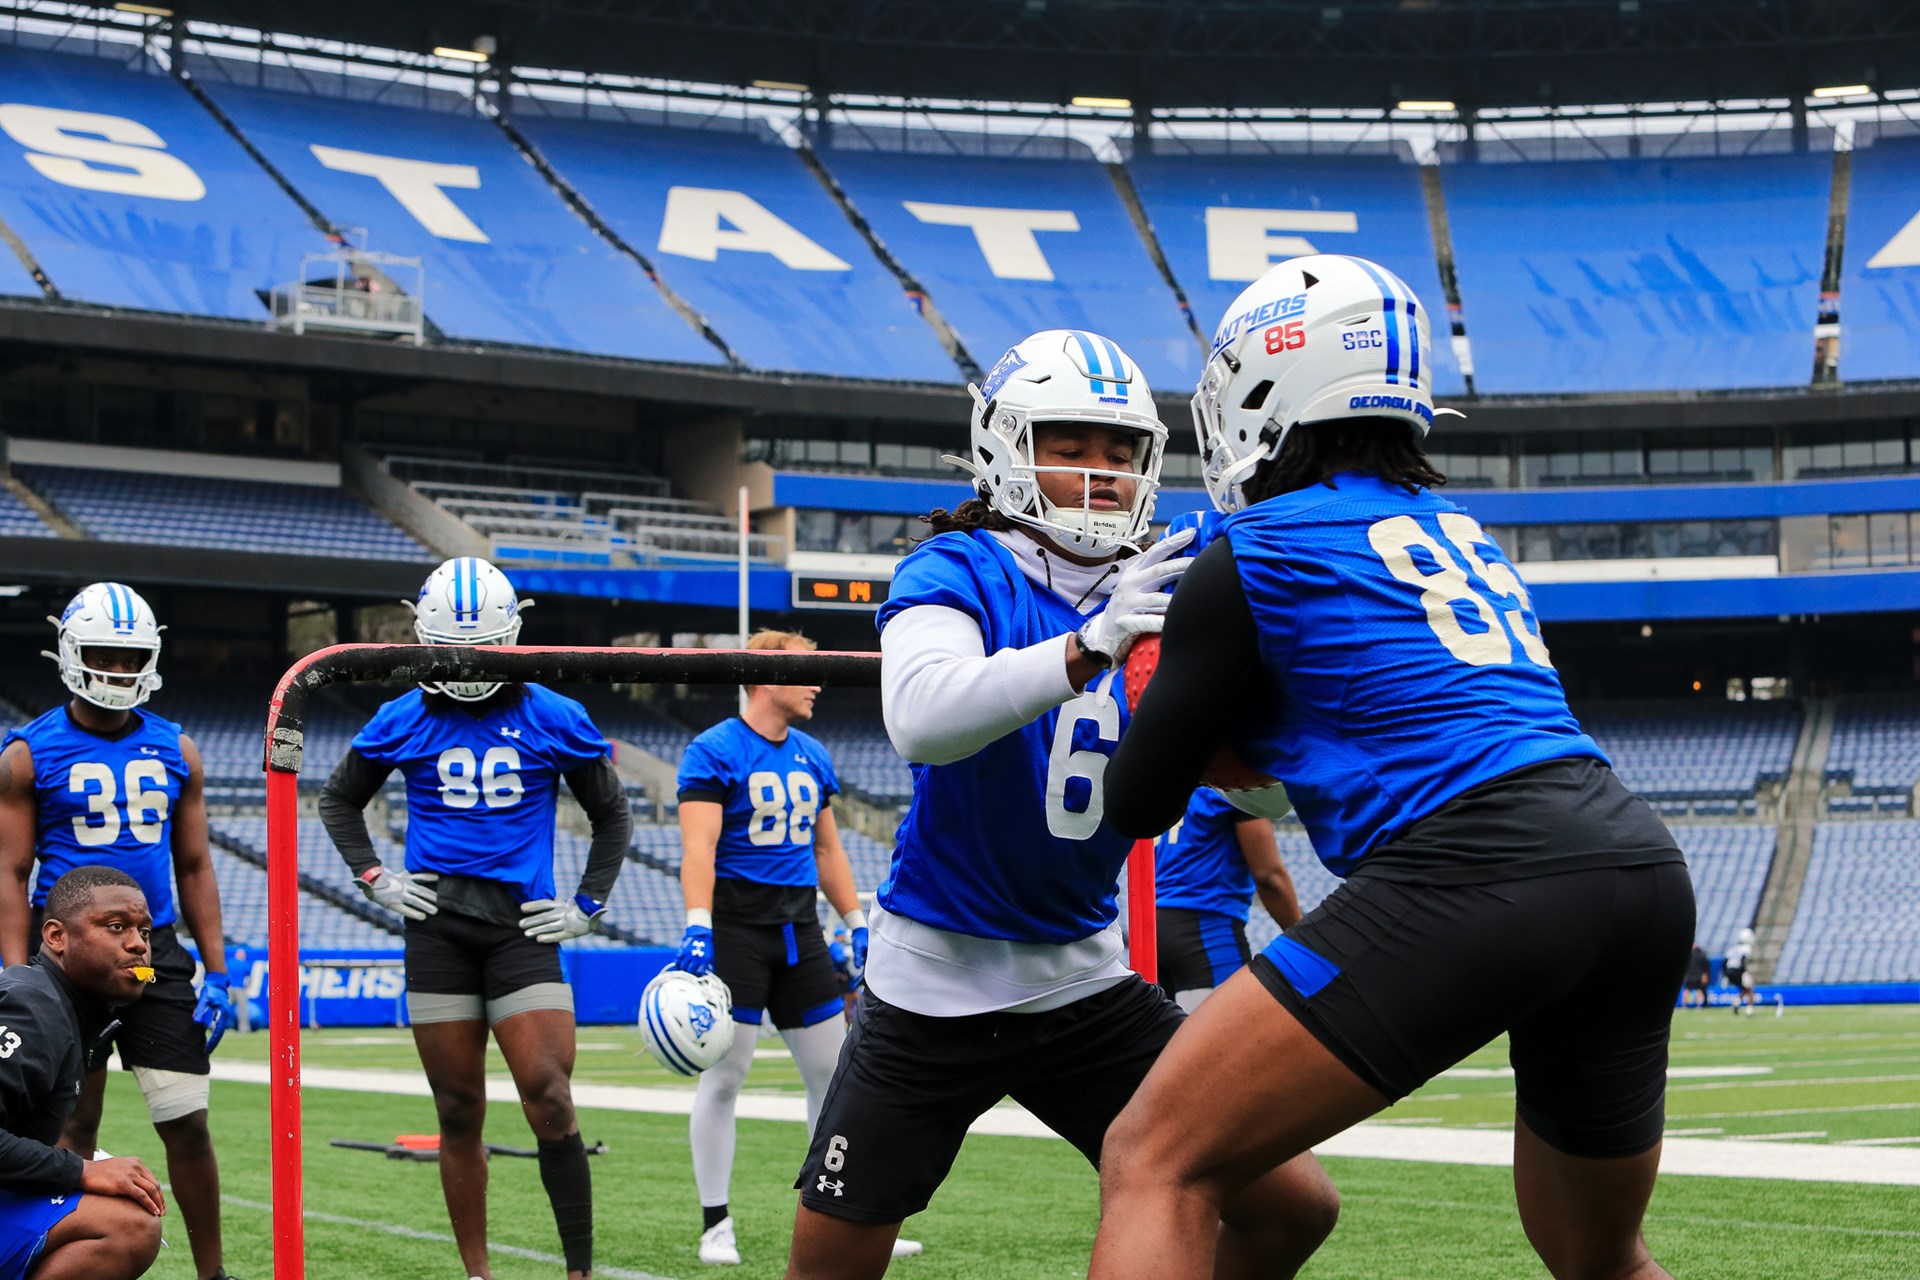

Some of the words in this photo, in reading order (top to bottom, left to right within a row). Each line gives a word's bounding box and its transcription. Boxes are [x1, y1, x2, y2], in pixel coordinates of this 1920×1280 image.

[0, 104, 1358, 281] STATE
[1210, 294, 1308, 356] ANTHERS
[1264, 321, 1306, 355] 85
[1342, 329, 1383, 351] SBC
[1349, 395, 1413, 411] GEORGIA
[1367, 512, 1556, 668] 85
[437, 746, 526, 809] 86
[1045, 691, 1120, 841] 6
[69, 759, 169, 846] 36
[748, 770, 819, 847] 88
[0, 1025, 22, 1059] 3
[824, 1134, 849, 1173] 6
